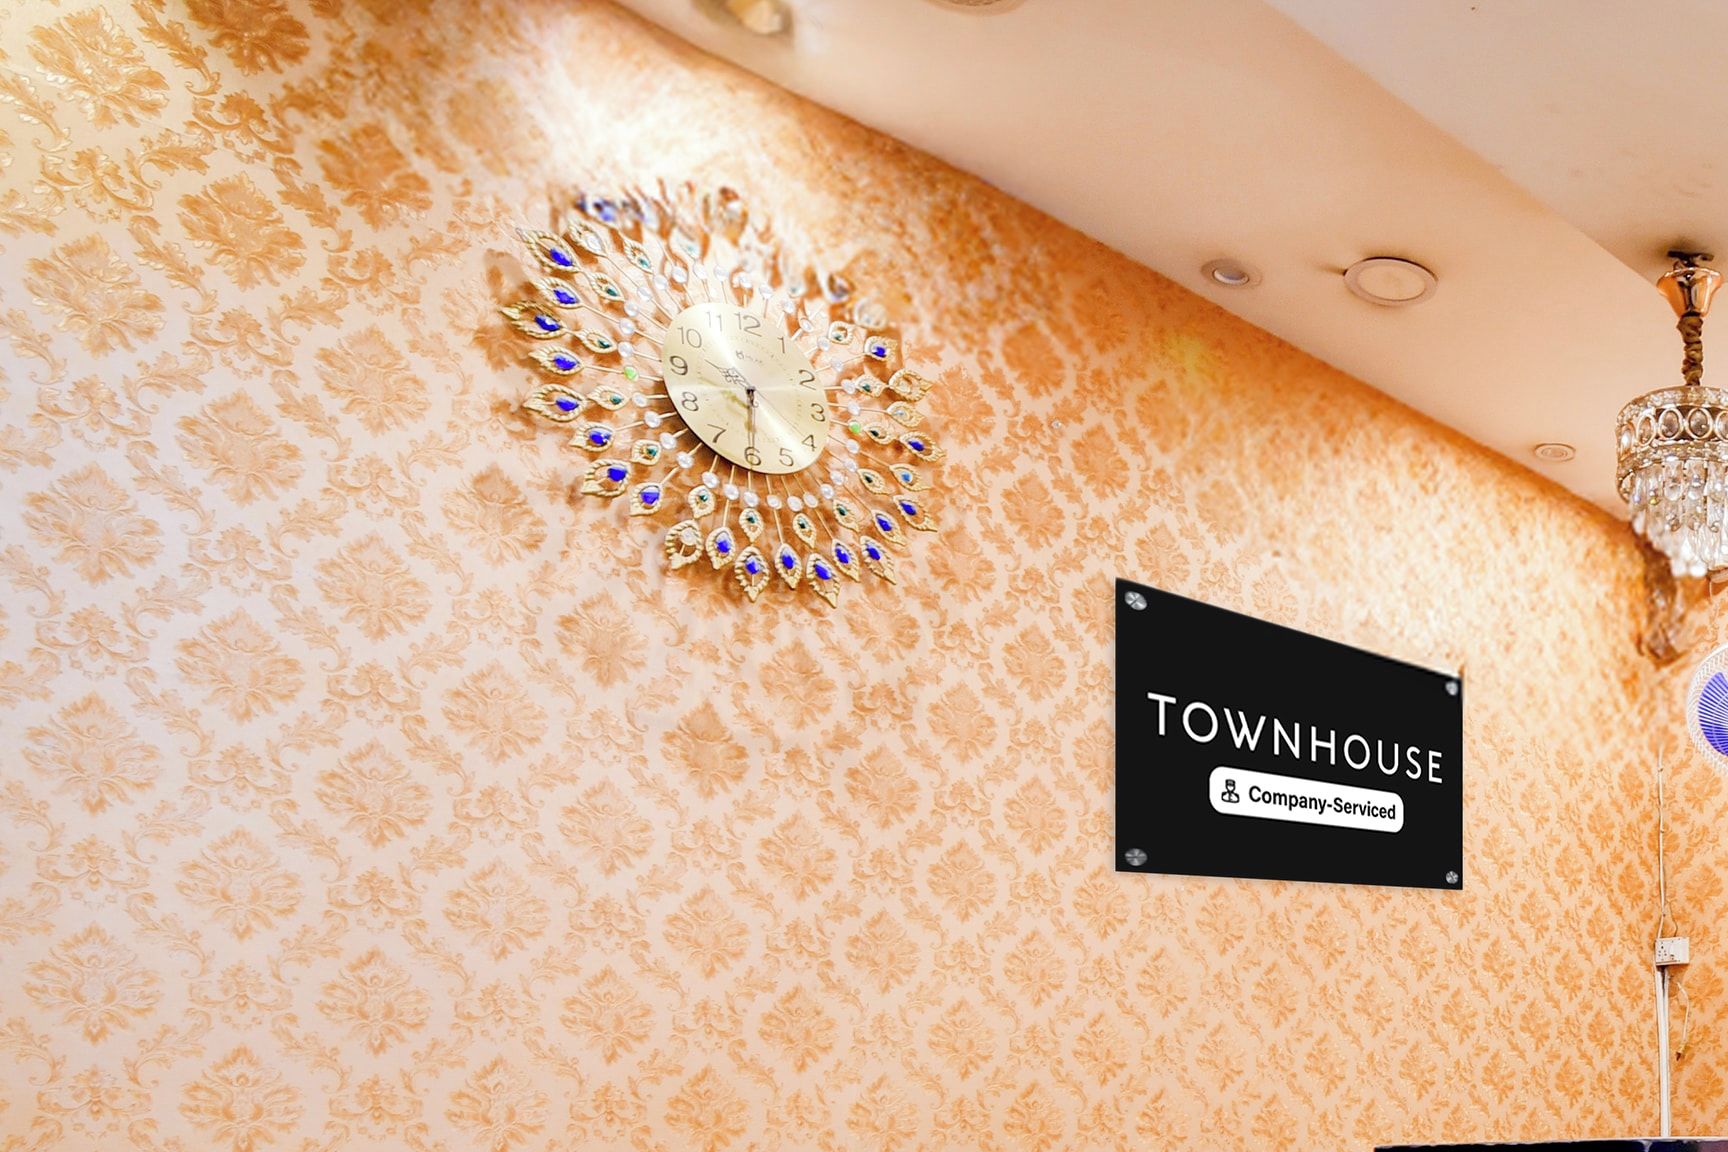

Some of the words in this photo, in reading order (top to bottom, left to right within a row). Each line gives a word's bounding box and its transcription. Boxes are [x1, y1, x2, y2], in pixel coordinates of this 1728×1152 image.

[706, 311, 723, 332] 11
[734, 312, 762, 337] 12
[677, 326, 703, 348] 10
[777, 336, 786, 354] 1
[669, 355, 689, 376] 9
[798, 369, 817, 391] 2
[681, 391, 699, 412] 8
[810, 403, 826, 422] 3
[706, 423, 727, 444] 7
[802, 434, 817, 452] 4
[743, 446, 762, 467] 6
[779, 447, 795, 467] 5
[1147, 692, 1443, 784] TOWNHOUSE
[1248, 785, 1396, 821] Company-Serviced
